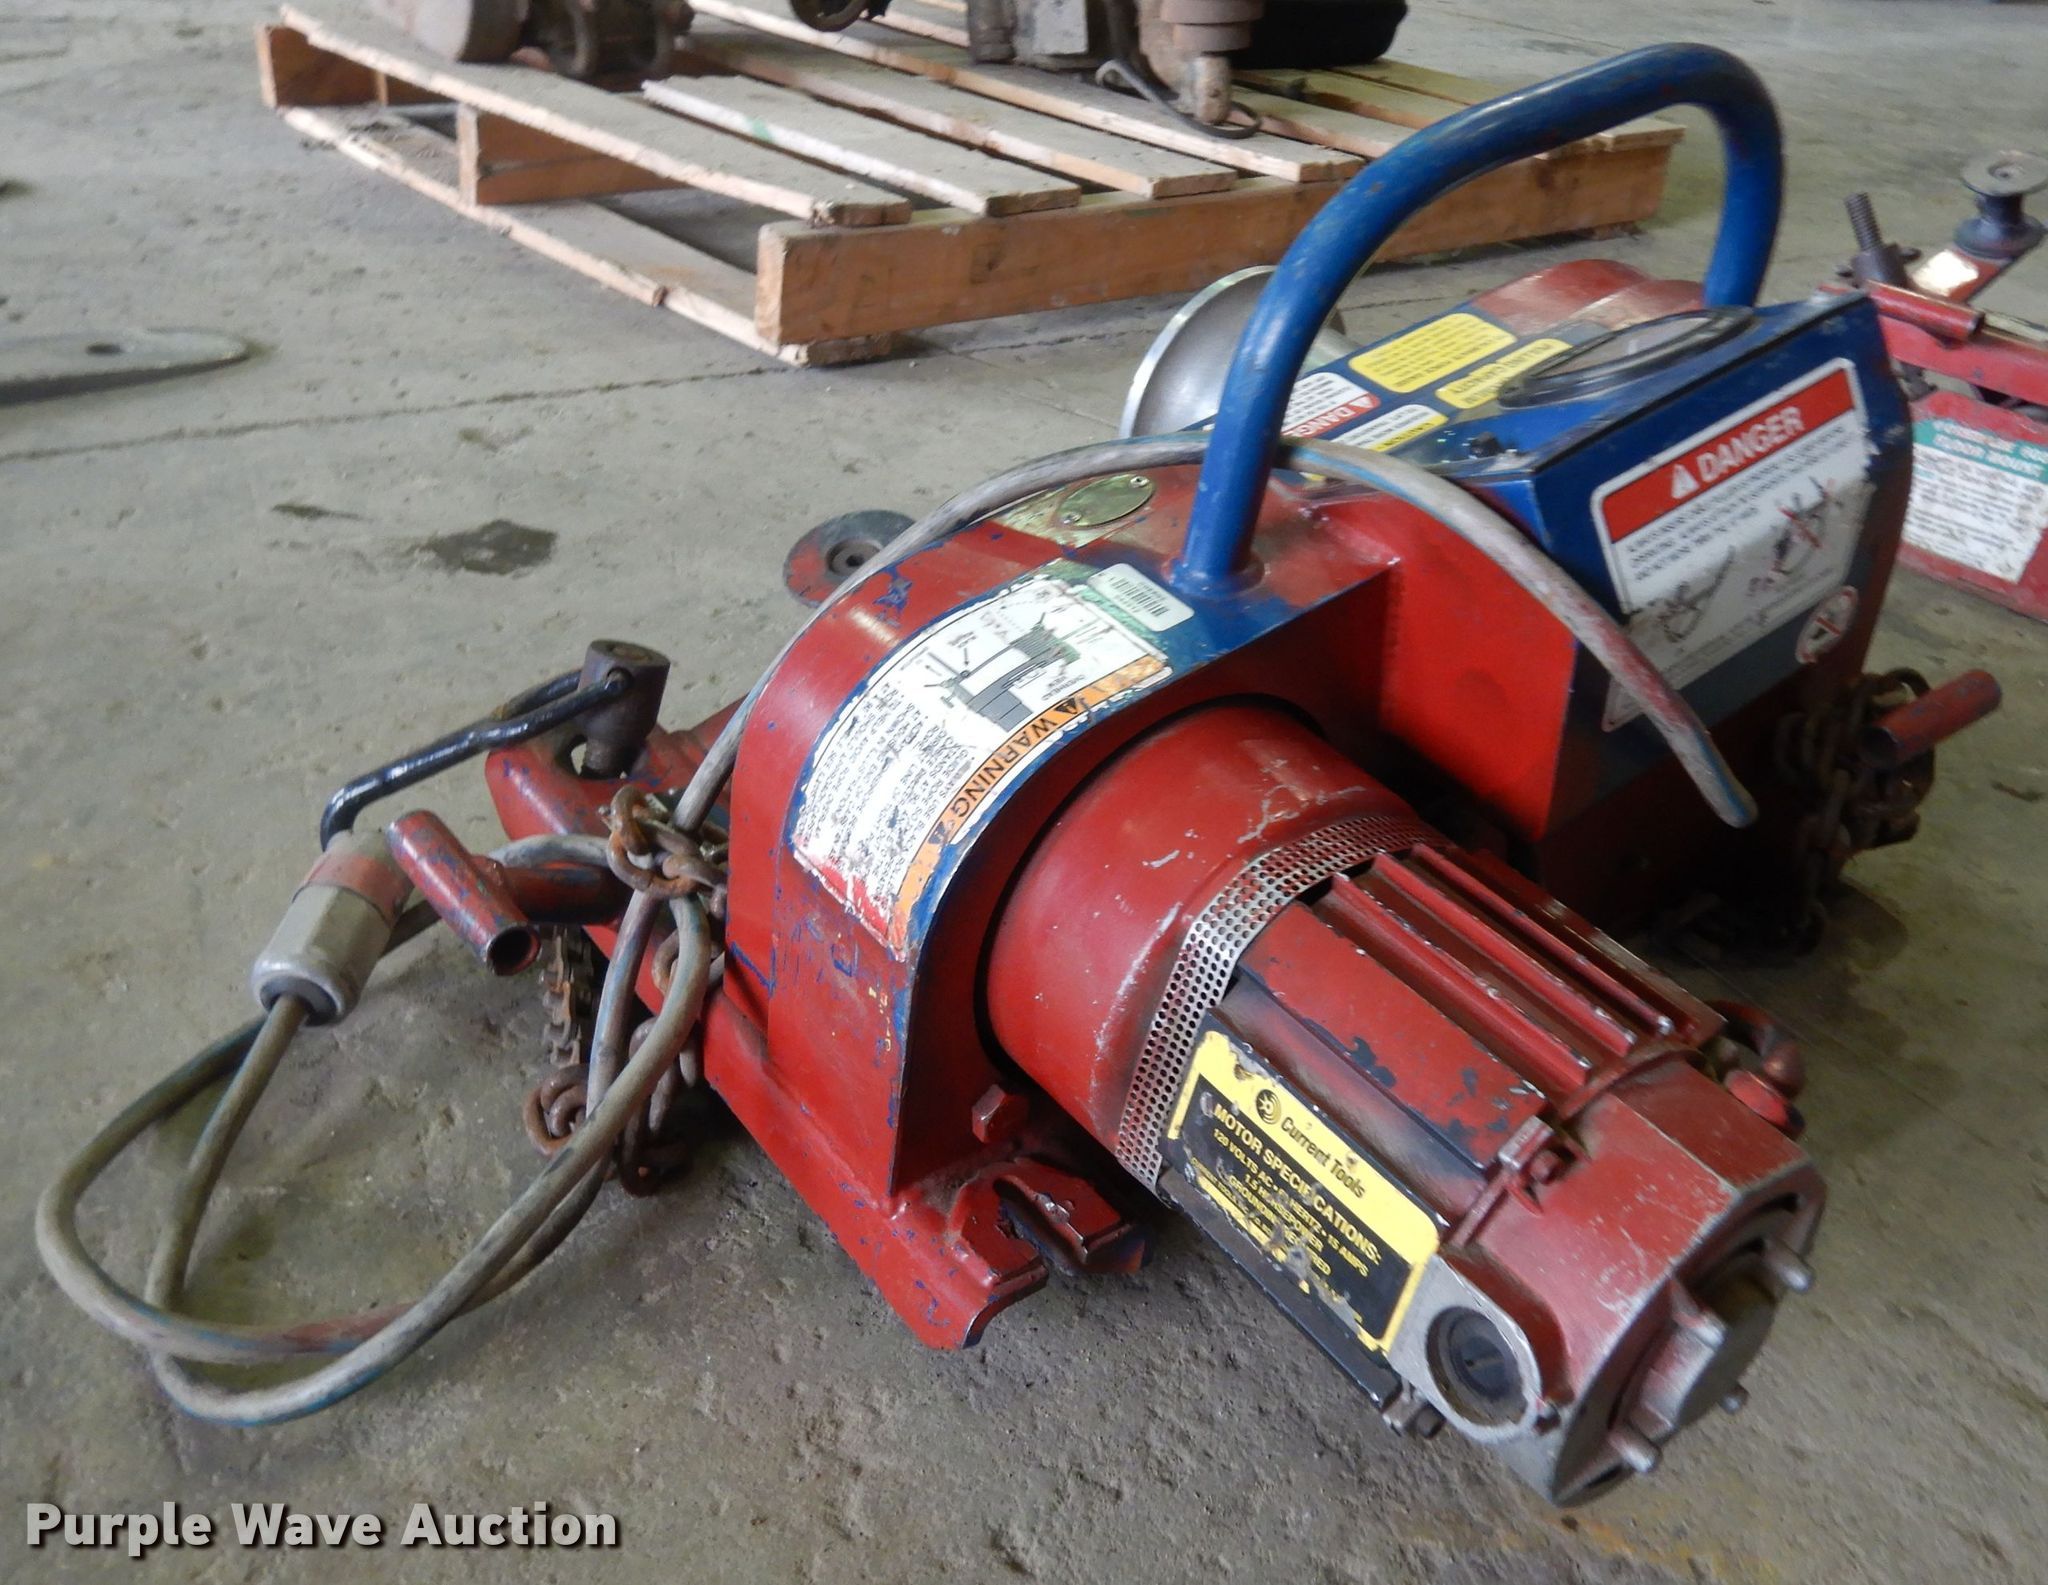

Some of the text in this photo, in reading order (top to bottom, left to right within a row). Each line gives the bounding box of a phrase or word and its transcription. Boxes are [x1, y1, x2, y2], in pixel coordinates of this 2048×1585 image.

[1698, 406, 1805, 482] DANGER
[955, 714, 1058, 820] WARNING
[1214, 1104, 1382, 1266] MOTOR SPECIFCATIONS:
[1280, 1116, 1365, 1200] Current Tools
[1229, 1143, 1257, 1174] VOLTS
[1257, 1169, 1272, 1187] AC
[1289, 1200, 1321, 1233] HERTZ
[1327, 1234, 1338, 1249] 15
[1339, 1245, 1368, 1277] AMPS
[1258, 1186, 1322, 1251] HRSEPOWER
